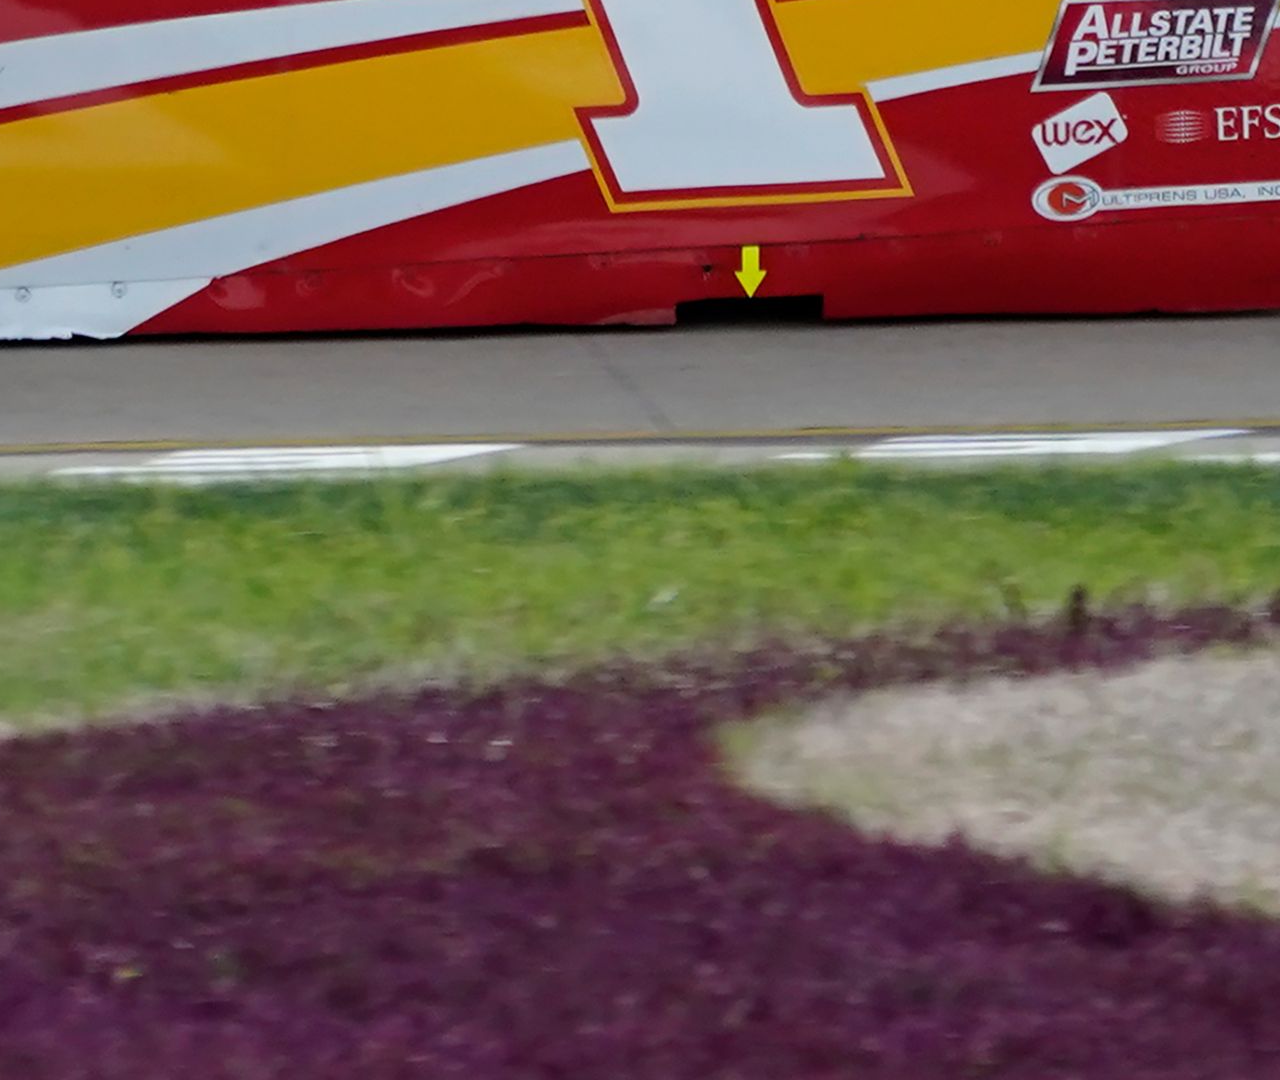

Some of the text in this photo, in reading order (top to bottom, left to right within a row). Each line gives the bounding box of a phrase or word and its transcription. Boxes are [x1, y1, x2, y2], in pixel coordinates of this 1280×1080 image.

[1072, 4, 1255, 41] ALLSTATE
[1064, 31, 1251, 76] PETERBILT
[1176, 61, 1239, 75] GROUP
[1040, 118, 1121, 147] wex
